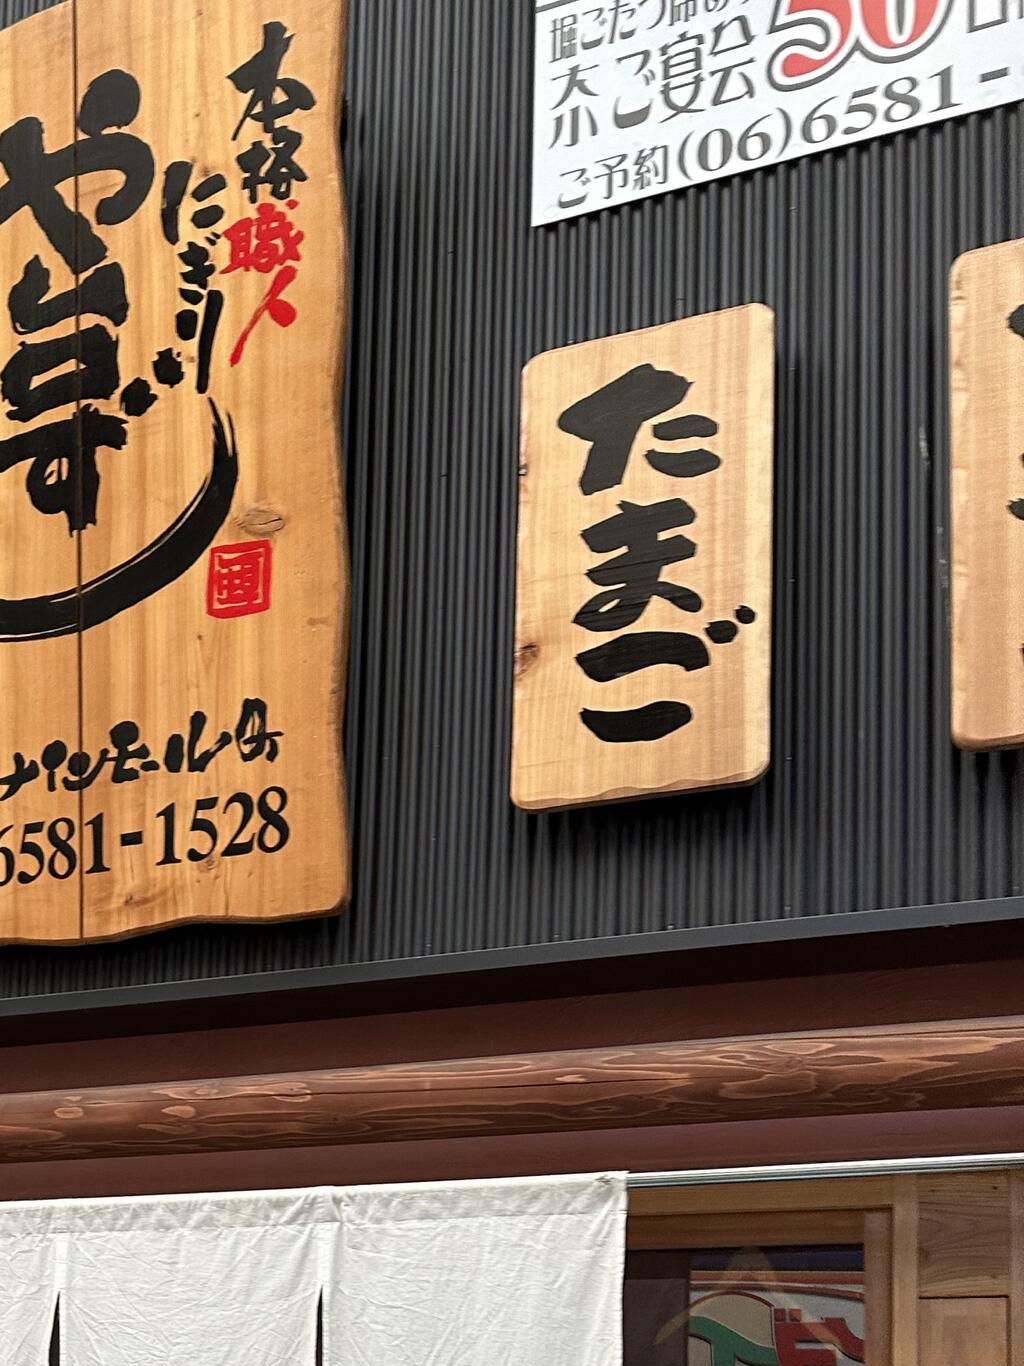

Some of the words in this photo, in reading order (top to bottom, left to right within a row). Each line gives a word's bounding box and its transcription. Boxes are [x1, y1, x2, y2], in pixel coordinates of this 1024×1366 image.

[160, 160, 226, 394] にぎり
[558, 363, 756, 743] たまご
